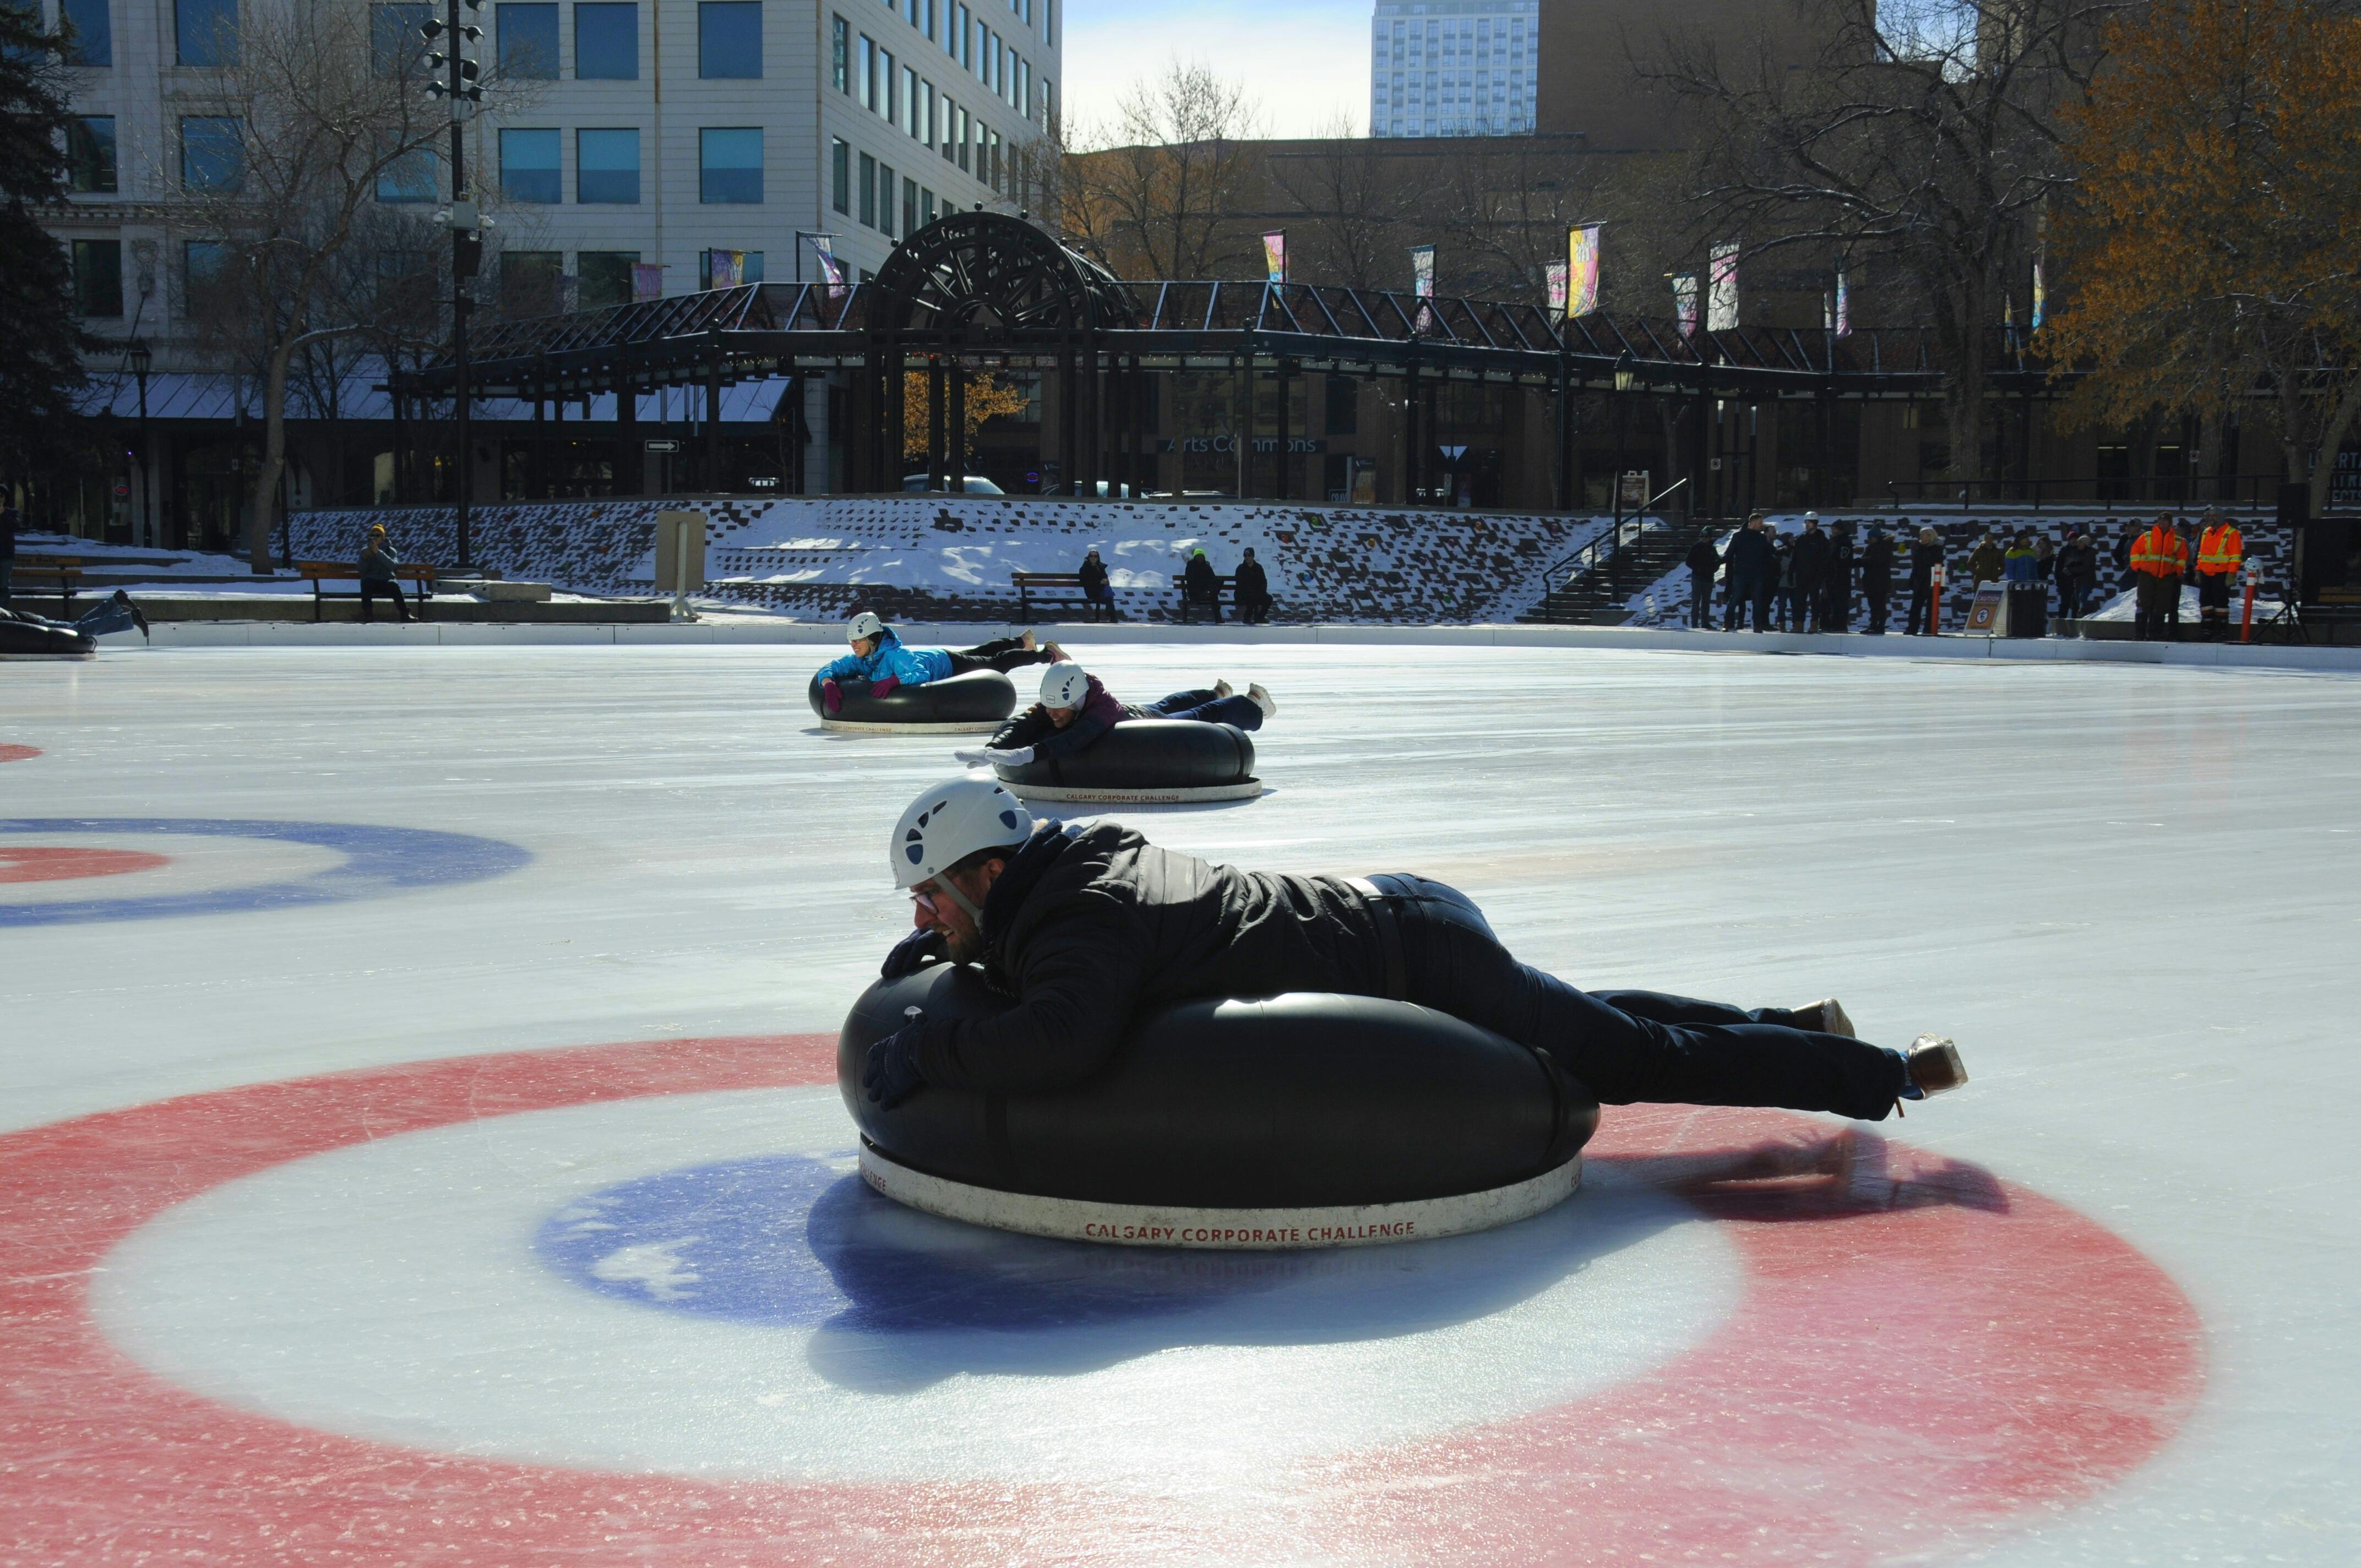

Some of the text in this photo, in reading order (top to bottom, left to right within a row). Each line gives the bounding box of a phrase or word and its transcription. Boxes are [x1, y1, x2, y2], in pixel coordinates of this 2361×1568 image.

[1086, 1222, 1415, 1242] CALGARY CORPORATE CHALLENGE
